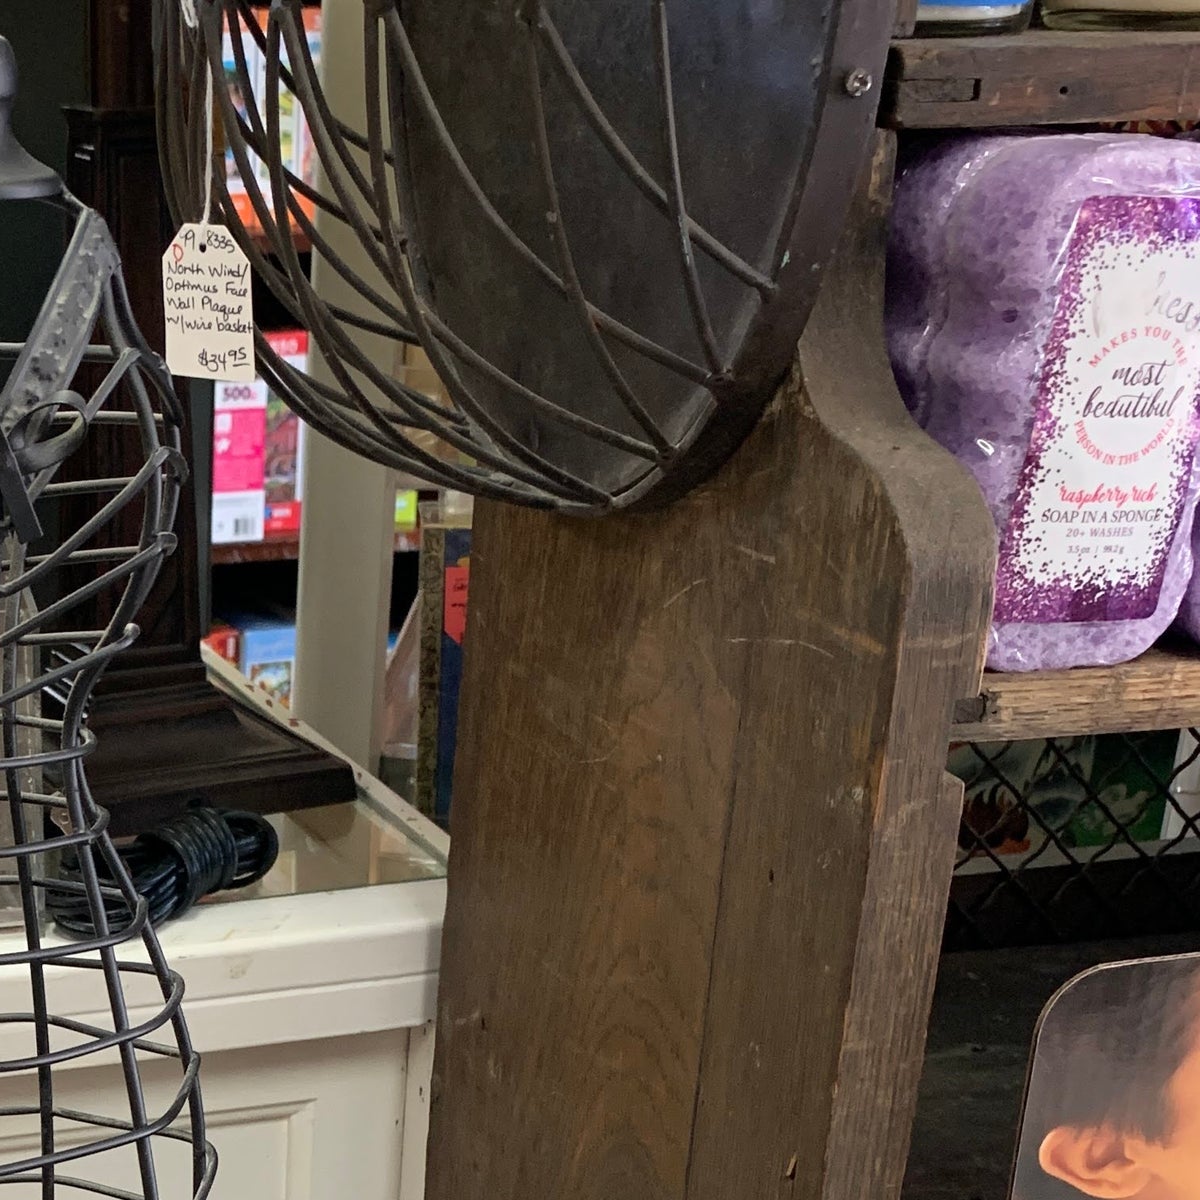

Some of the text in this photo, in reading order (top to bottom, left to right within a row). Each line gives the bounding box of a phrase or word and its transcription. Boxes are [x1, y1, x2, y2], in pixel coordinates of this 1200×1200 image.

[168, 261, 205, 276] North
[166, 277, 248, 298] Optimus Face
[167, 296, 243, 322] Wall Plaque
[217, 317, 253, 335] basket
[1088, 326, 1188, 368] MAKES YOU THE
[1112, 360, 1175, 387] most
[1082, 386, 1185, 418] beautiful
[1074, 418, 1175, 466] PERSON IN THE WORLD
[1059, 482, 1158, 510] raspberry rich
[1041, 508, 1163, 524] SOAP IN A SPONGE
[1066, 526, 1135, 538] 20+ WASHES
